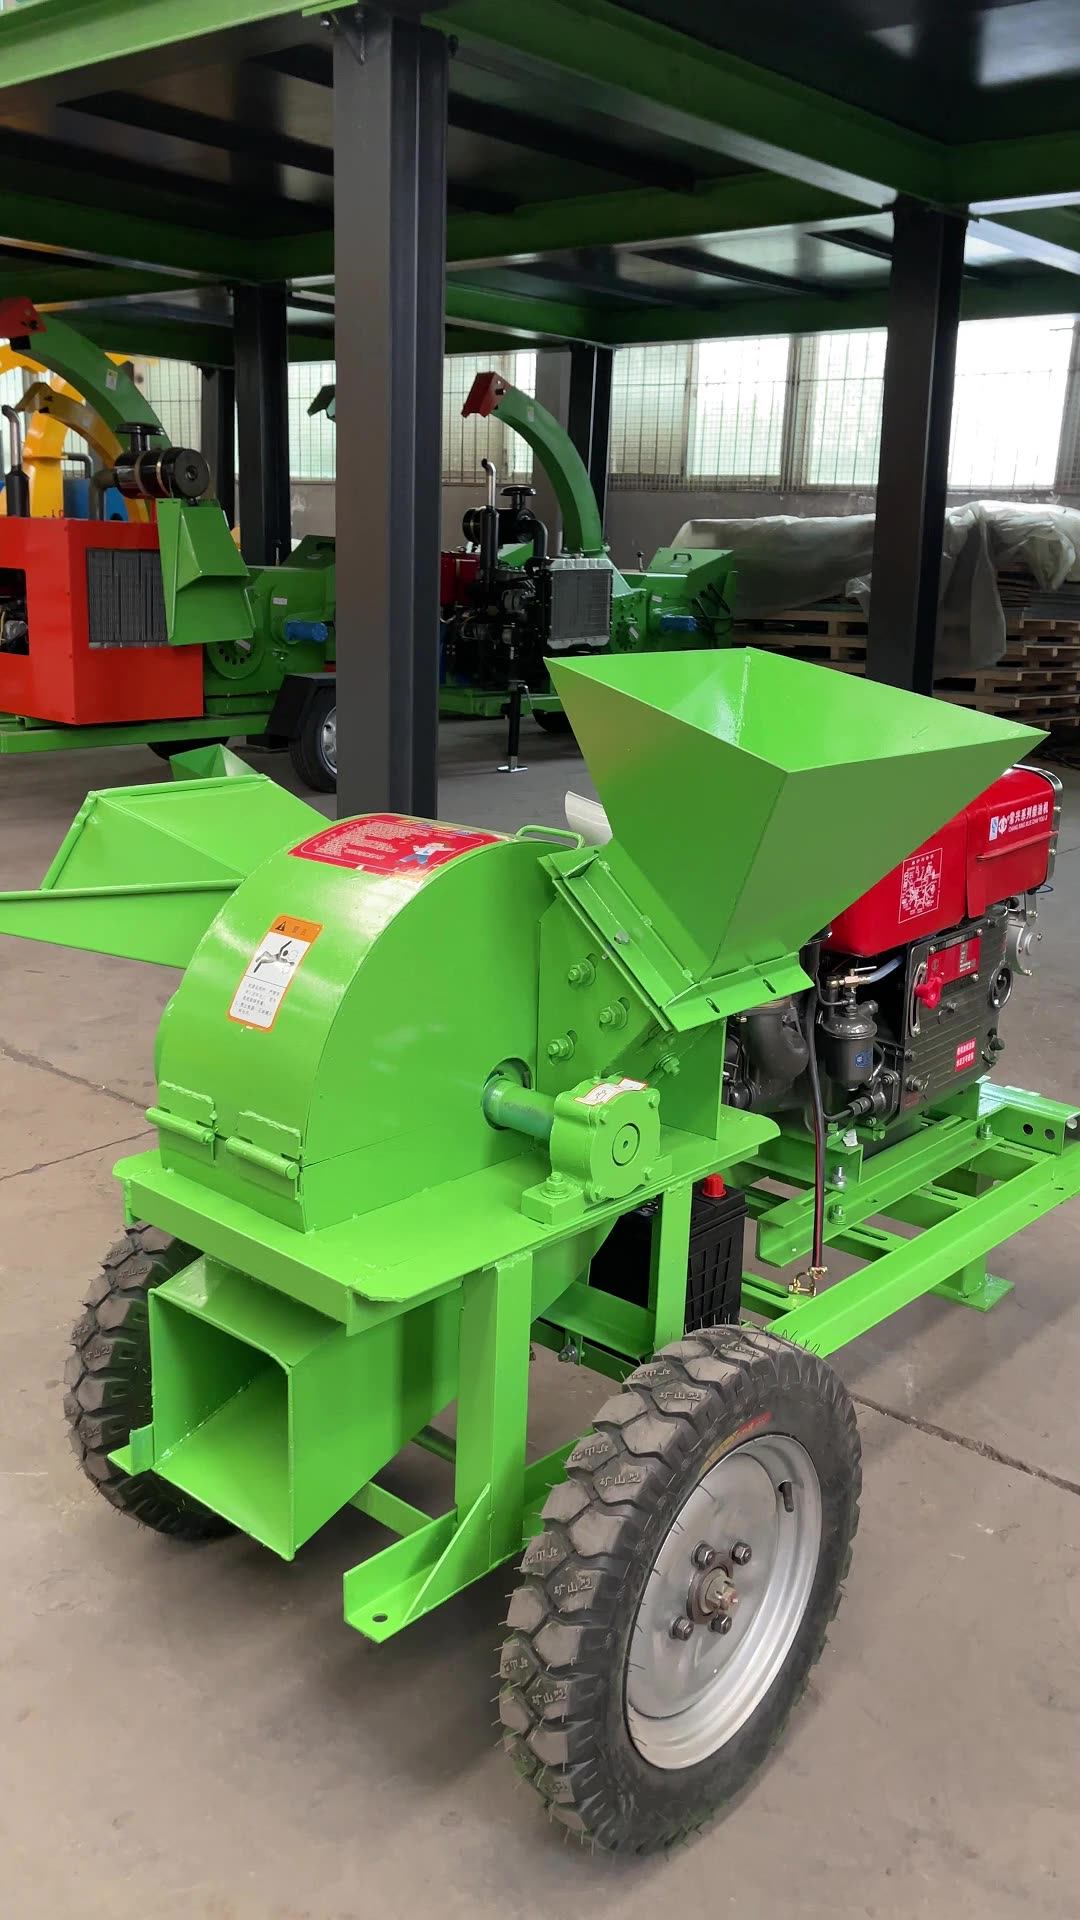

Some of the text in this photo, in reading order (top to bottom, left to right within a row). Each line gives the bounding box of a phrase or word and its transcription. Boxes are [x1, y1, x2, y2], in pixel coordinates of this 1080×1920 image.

[599, 1472, 641, 1486] 矿山型
[553, 1575, 593, 1595] 矿山型
